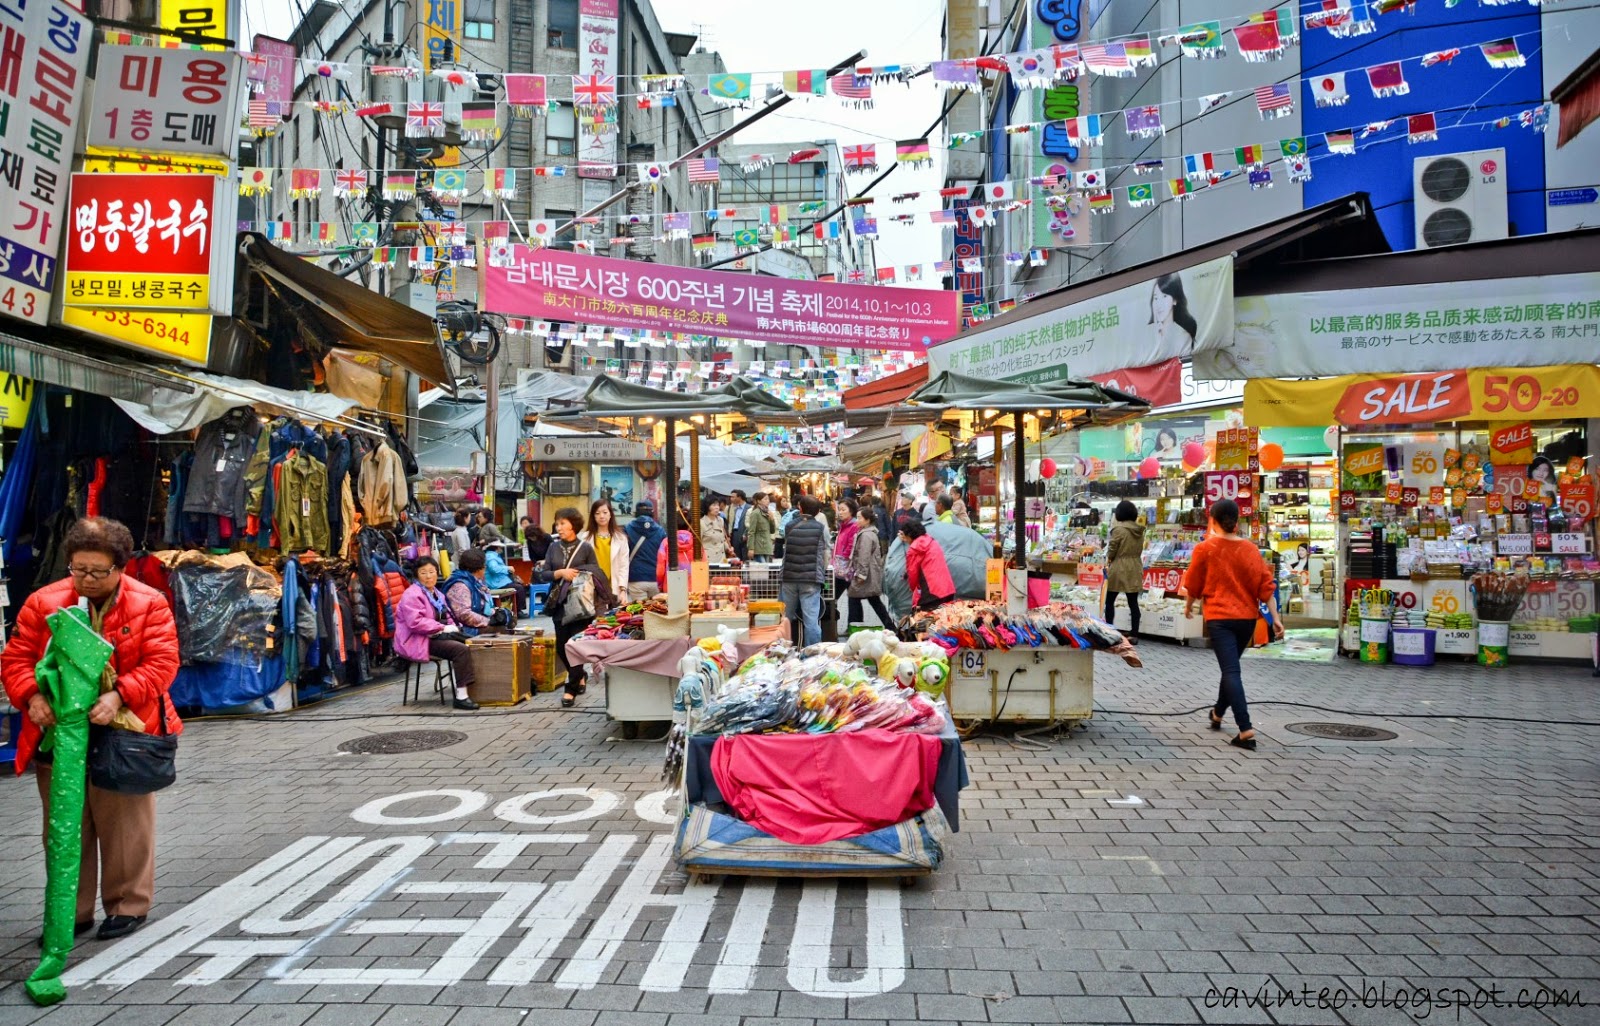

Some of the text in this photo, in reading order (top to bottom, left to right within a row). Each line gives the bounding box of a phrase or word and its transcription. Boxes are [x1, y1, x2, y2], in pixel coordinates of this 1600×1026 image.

[104, 108, 216, 146] 1층 도매
[1482, 176, 1496, 184] LG
[76, 198, 208, 255] 명동칼국수
[506, 257, 630, 298] 남대문시장
[637, 276, 726, 310] 600주년
[732, 286, 774, 314] 기념
[780, 290, 823, 318] 축제
[543, 291, 729, 327] 南大门市场六百周年纪念庆典
[1340, 325, 1546, 350] 最高のサービスで感動をあたえる
[1359, 373, 1455, 421] SALE
[1496, 426, 1530, 447] SALE
[562, 441, 589, 449] Tourist
[1349, 451, 1381, 471] SALE
[1388, 489, 1399, 498] 50
[1526, 486, 1537, 494] 50
[1567, 487, 1587, 495] SALE
[1403, 493, 1417, 502] 50
[1431, 492, 1443, 500] 50
[1341, 497, 1354, 505] 50
[1489, 500, 1500, 508] 50
[1513, 501, 1527, 511] 50
[1536, 536, 1549, 545] 50
[1559, 545, 1579, 553] SALE
[1143, 572, 1165, 587] ALE
[958, 651, 985, 669] 164
